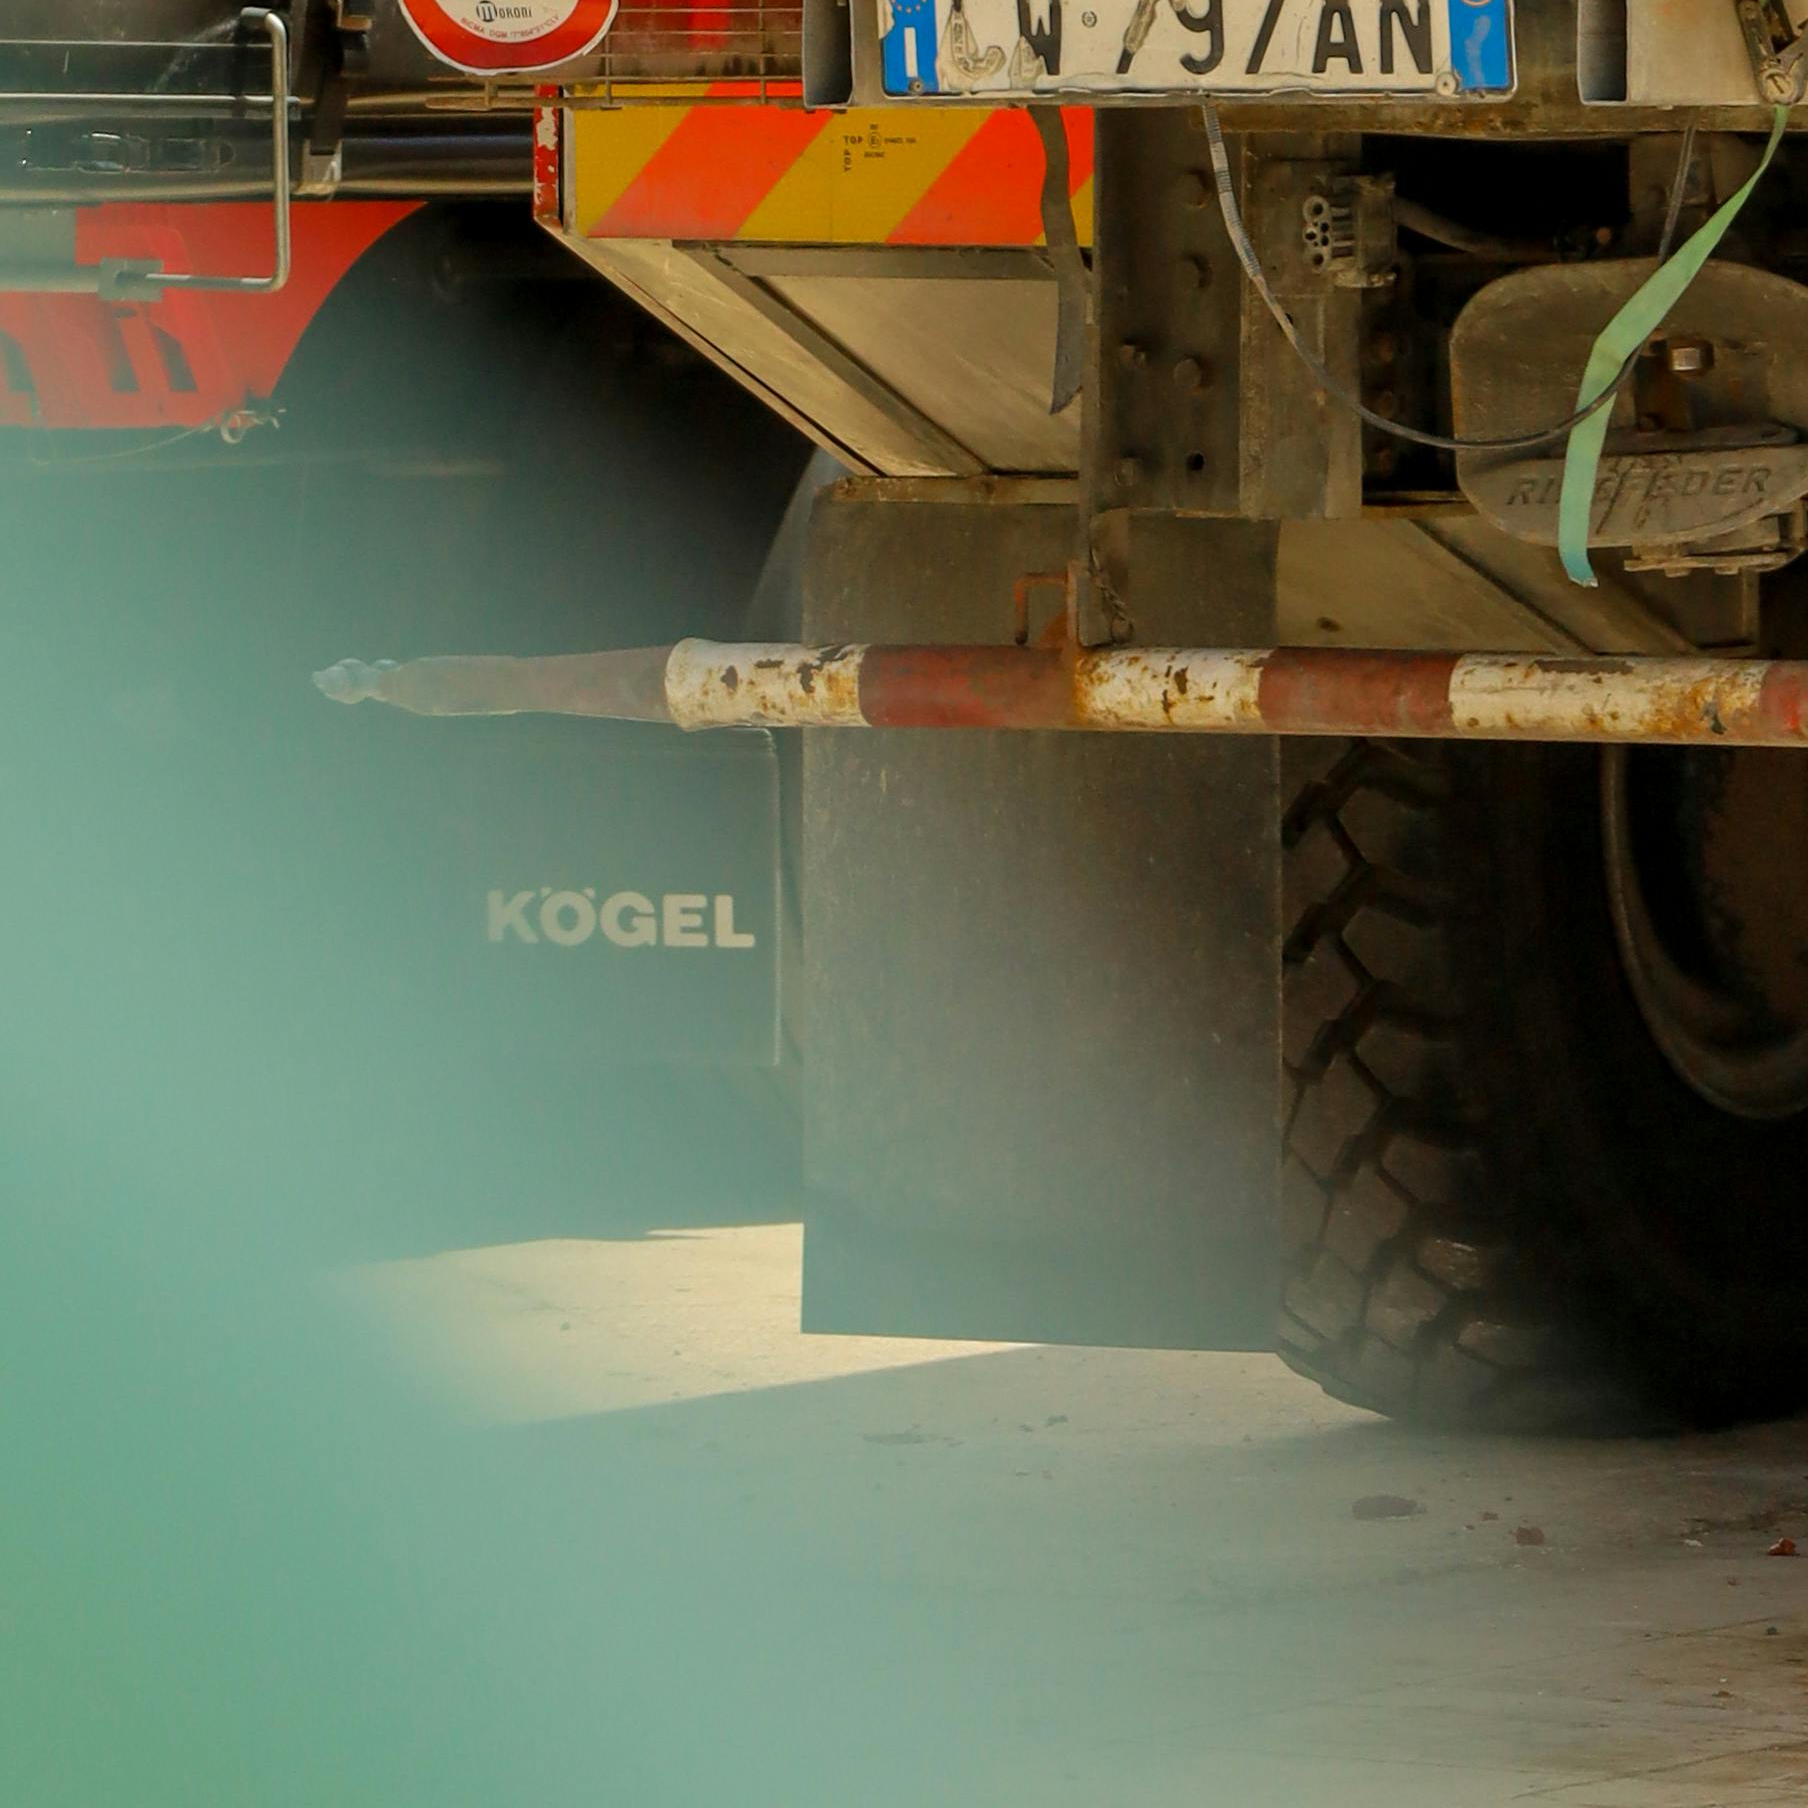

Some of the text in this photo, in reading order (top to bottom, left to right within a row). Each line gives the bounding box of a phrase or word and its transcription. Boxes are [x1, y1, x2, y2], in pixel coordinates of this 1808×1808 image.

[843, 135, 863, 145] TOP
[1506, 463, 1773, 506] RIGFEDER
[486, 887, 755, 949] KÖGEL
